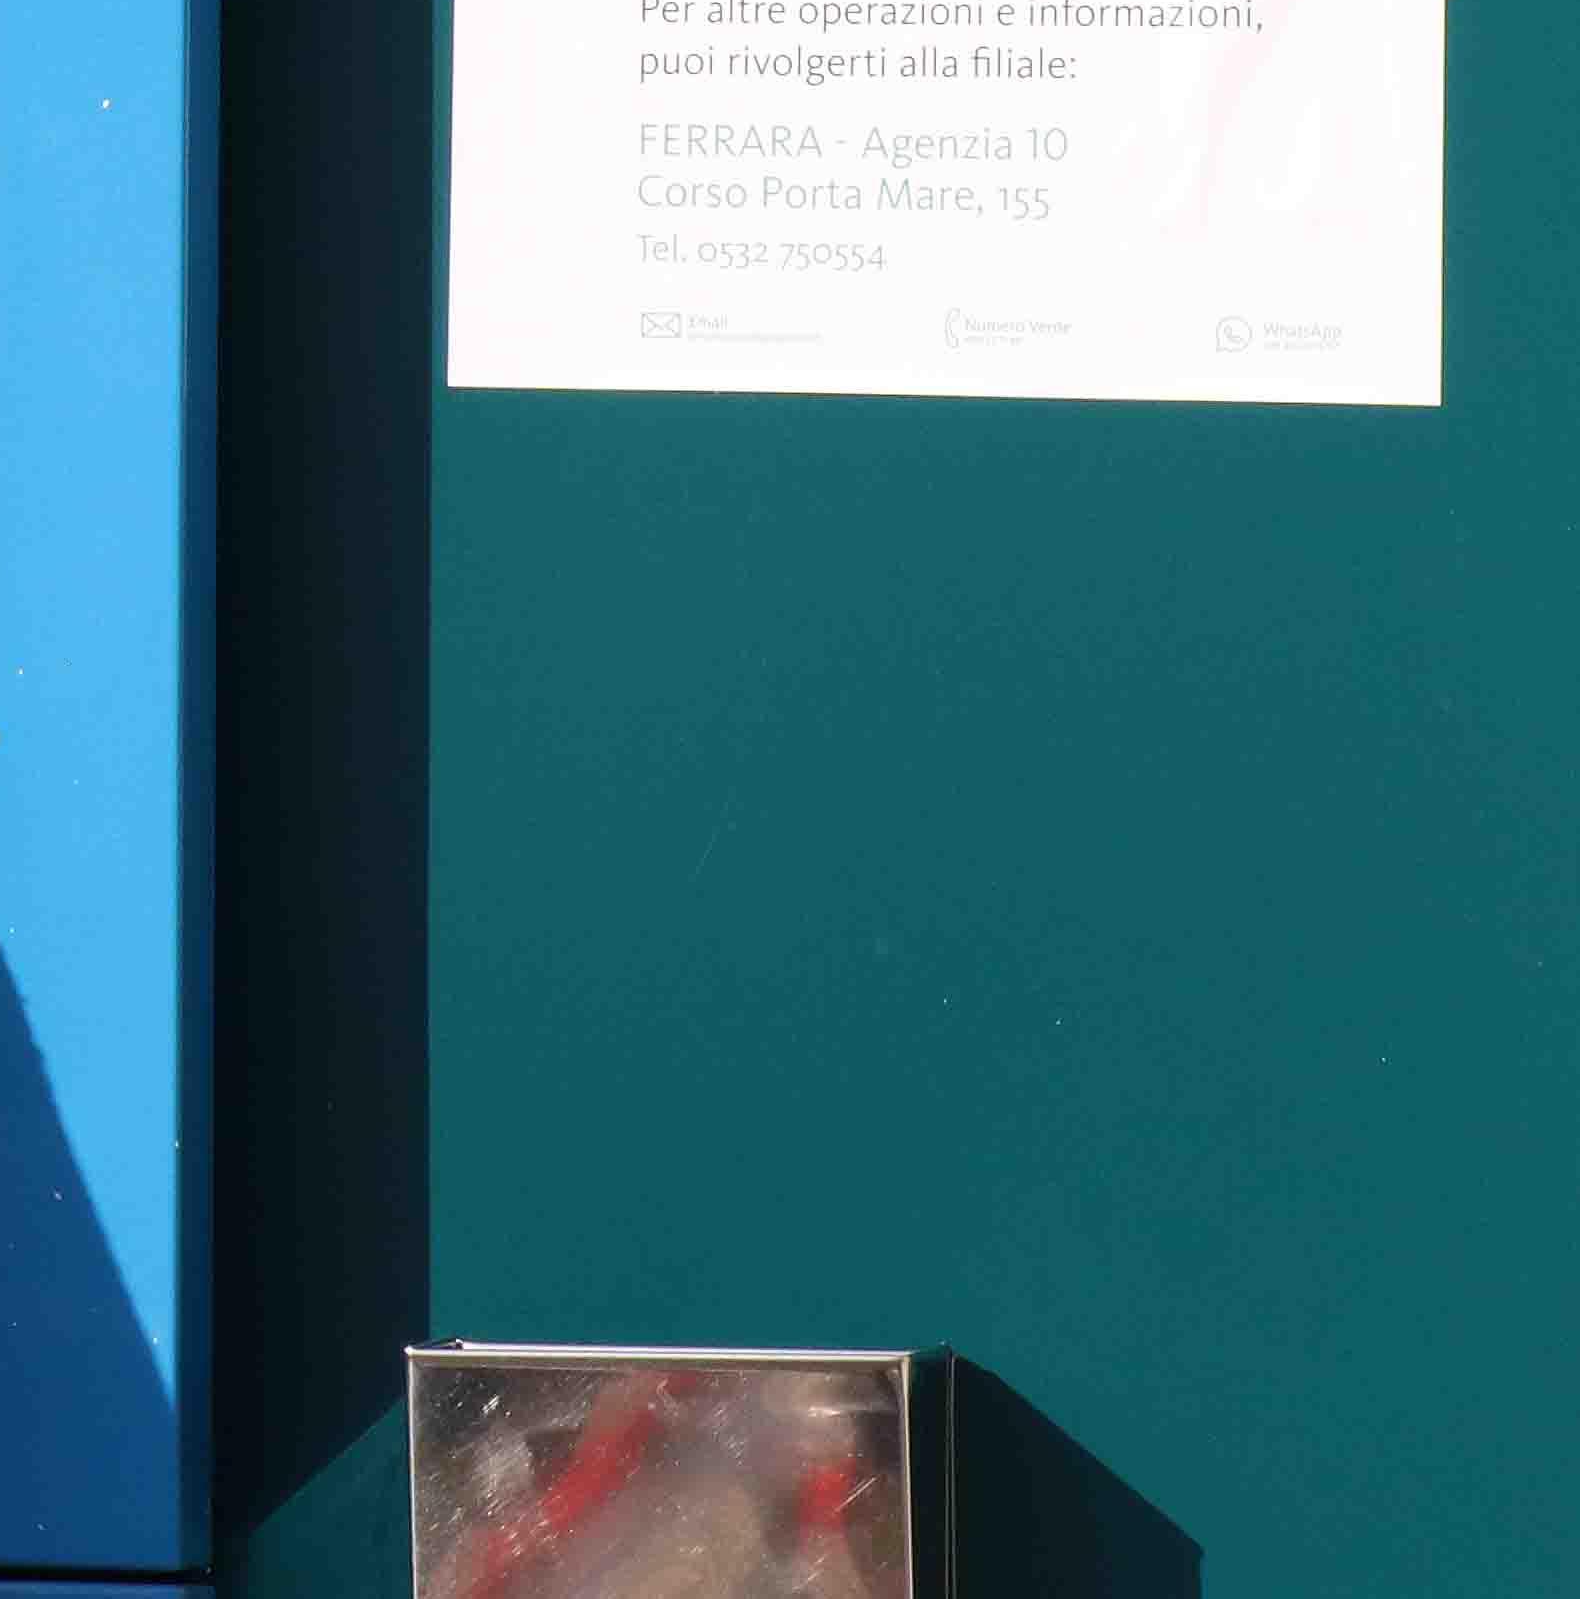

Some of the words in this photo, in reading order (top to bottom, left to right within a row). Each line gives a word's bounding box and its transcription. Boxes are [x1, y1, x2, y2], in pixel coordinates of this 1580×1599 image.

[997, 4, 1015, 26] e
[640, 46, 712, 83] puoi
[729, 45, 885, 86] rivolgerti
[900, 47, 957, 77] alla
[971, 46, 1075, 79] filiale:
[641, 123, 822, 157] FERRARA
[862, 127, 1011, 169] Agenzia
[1027, 128, 1067, 162] 10
[638, 175, 747, 208] Corso
[763, 176, 861, 210] Porta
[878, 178, 983, 215] Mare,
[1000, 188, 1050, 220] 155
[637, 234, 686, 262] Tel.
[697, 242, 768, 269] 0532
[780, 242, 887, 272] 750554
[1263, 321, 1343, 340] WhatsApp
